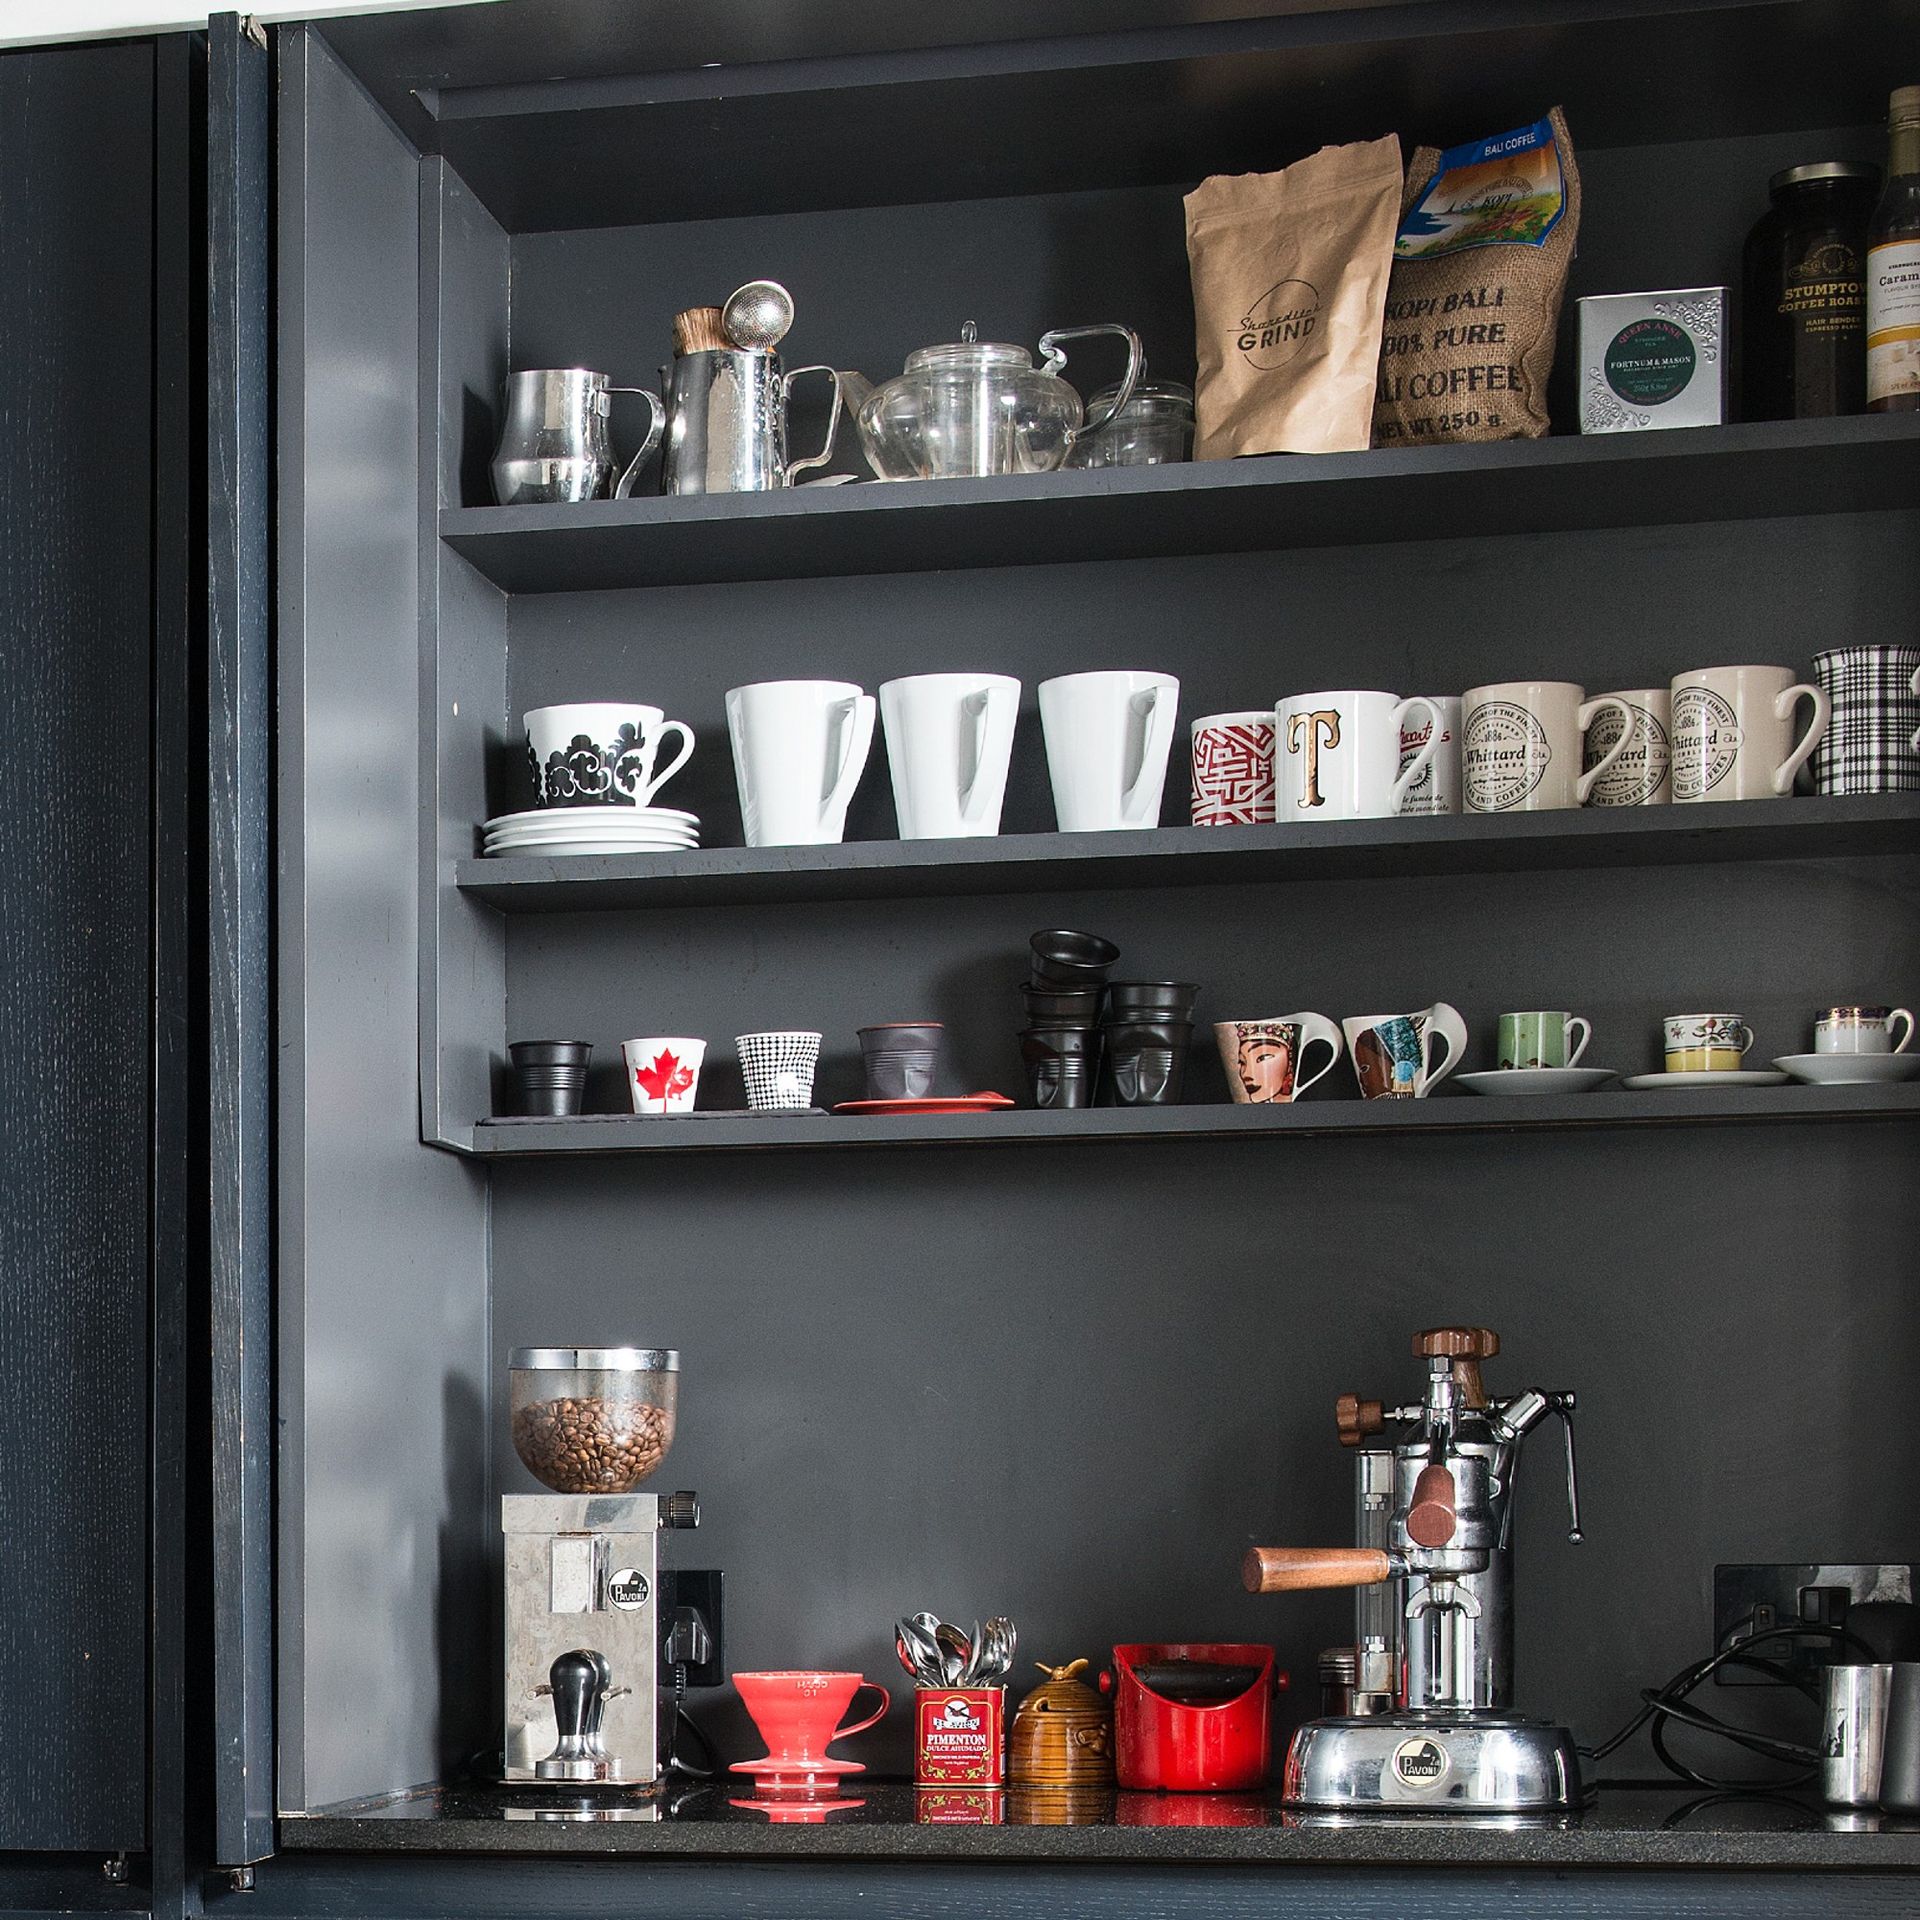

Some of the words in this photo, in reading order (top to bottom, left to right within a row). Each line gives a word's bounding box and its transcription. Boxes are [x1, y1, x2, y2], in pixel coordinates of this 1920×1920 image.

[1484, 142, 1504, 156] BALI
[1505, 132, 1536, 151] COFFEE
[1879, 273, 1919, 287] Caram
[1441, 288, 1504, 313] BALI
[1777, 299, 1825, 313] COFFEE
[1829, 297, 1864, 306] ROAS
[1829, 317, 1860, 325] BENDE
[1237, 317, 1315, 351] GRIND
[1433, 323, 1506, 349] PURE
[1619, 323, 1651, 344] QUEEN
[1655, 323, 1682, 340] ANNE
[1610, 359, 1653, 369] FORTNUM
[1662, 356, 1691, 365] MASON
[1409, 365, 1523, 399] COFFEE
[1439, 410, 1480, 432] 250
[1500, 709, 1515, 719] THE
[1707, 700, 1730, 724] FINEST
[1484, 729, 1502, 743] 1886
[1672, 729, 1718, 750] hittad
[1286, 708, 1342, 810] T
[1466, 745, 1526, 765] Whittard
[1691, 754, 1728, 790] COFEES
[614, 1584, 645, 1603] PAVONI
[926, 1734, 987, 1746] PIMENTON
[1403, 1757, 1437, 1775] PAVONI
